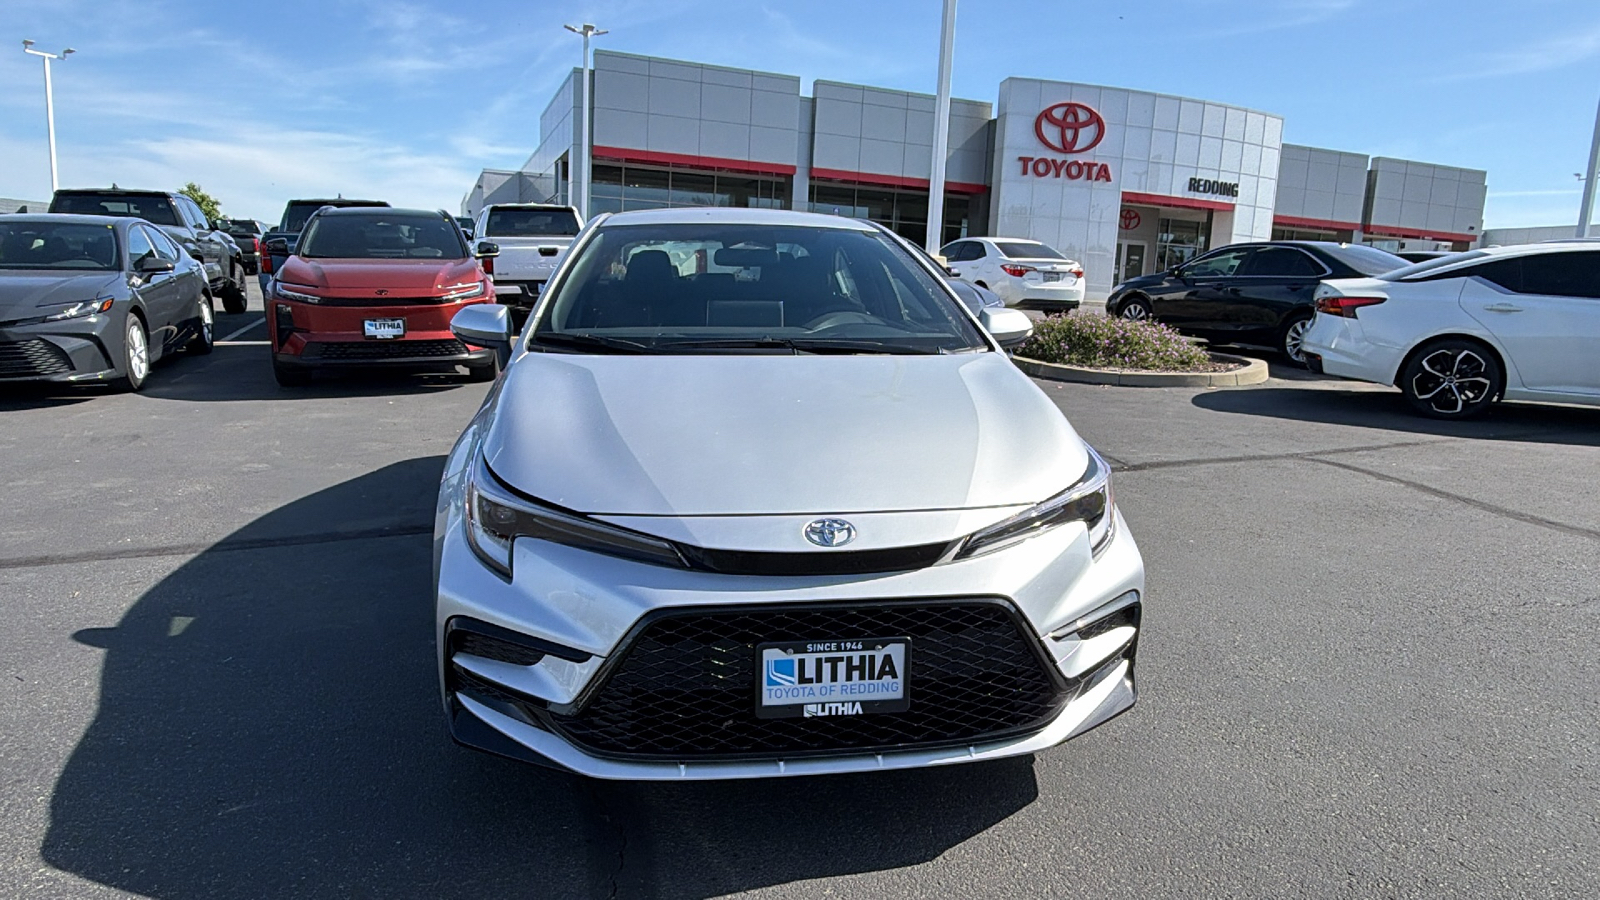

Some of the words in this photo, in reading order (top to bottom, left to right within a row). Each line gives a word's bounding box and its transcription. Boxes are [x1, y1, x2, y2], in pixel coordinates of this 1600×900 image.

[1018, 156, 1112, 182] TOYOTA
[1188, 177, 1239, 197] REDDING
[374, 322, 402, 330] LITHIA
[806, 643, 837, 652] SINCE
[840, 641, 863, 651] 1946
[797, 654, 899, 685] LITHIA
[766, 687, 816, 699] TOYOTA
[819, 685, 837, 697] OF
[840, 682, 899, 695] REDDING
[818, 702, 863, 716] LITHIA
